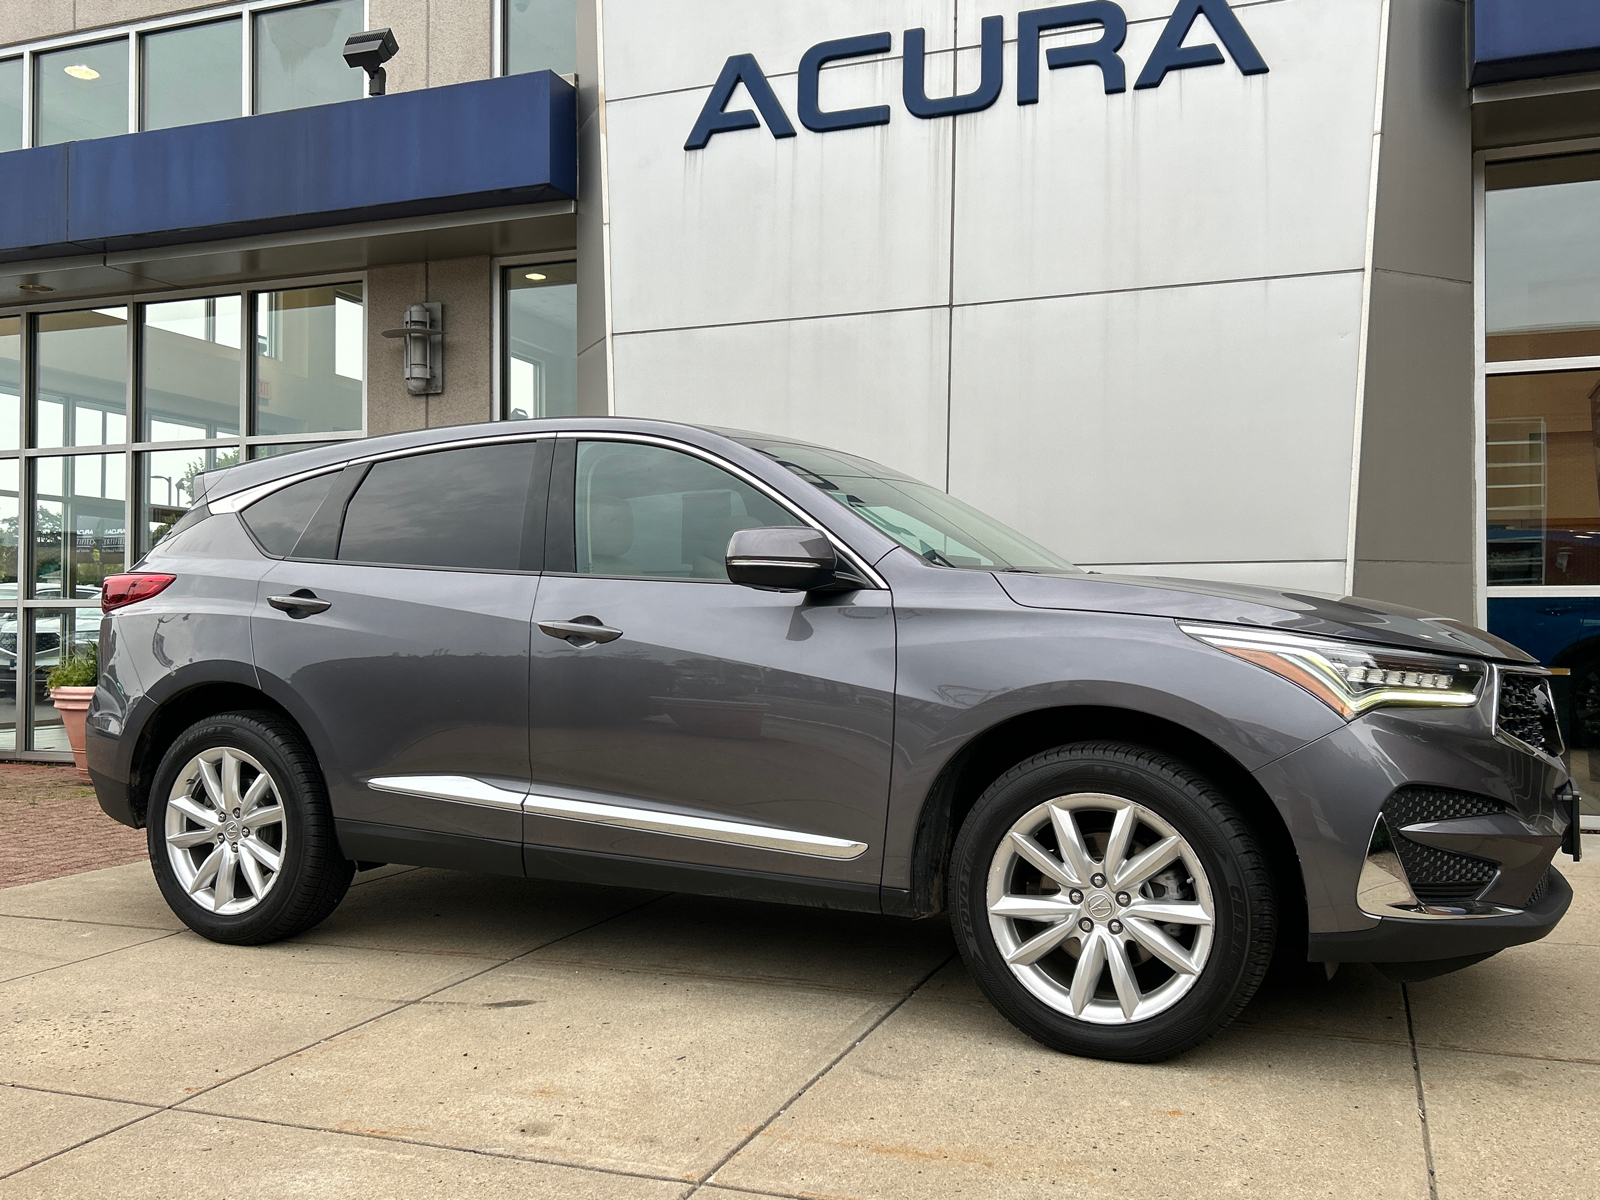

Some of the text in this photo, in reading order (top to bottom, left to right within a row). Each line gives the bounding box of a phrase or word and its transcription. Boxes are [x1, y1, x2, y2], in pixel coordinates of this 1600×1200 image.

[684, 0, 1269, 151] ACURA
[77, 538, 95, 546] TIFIED
[958, 883, 974, 940] TOYO
